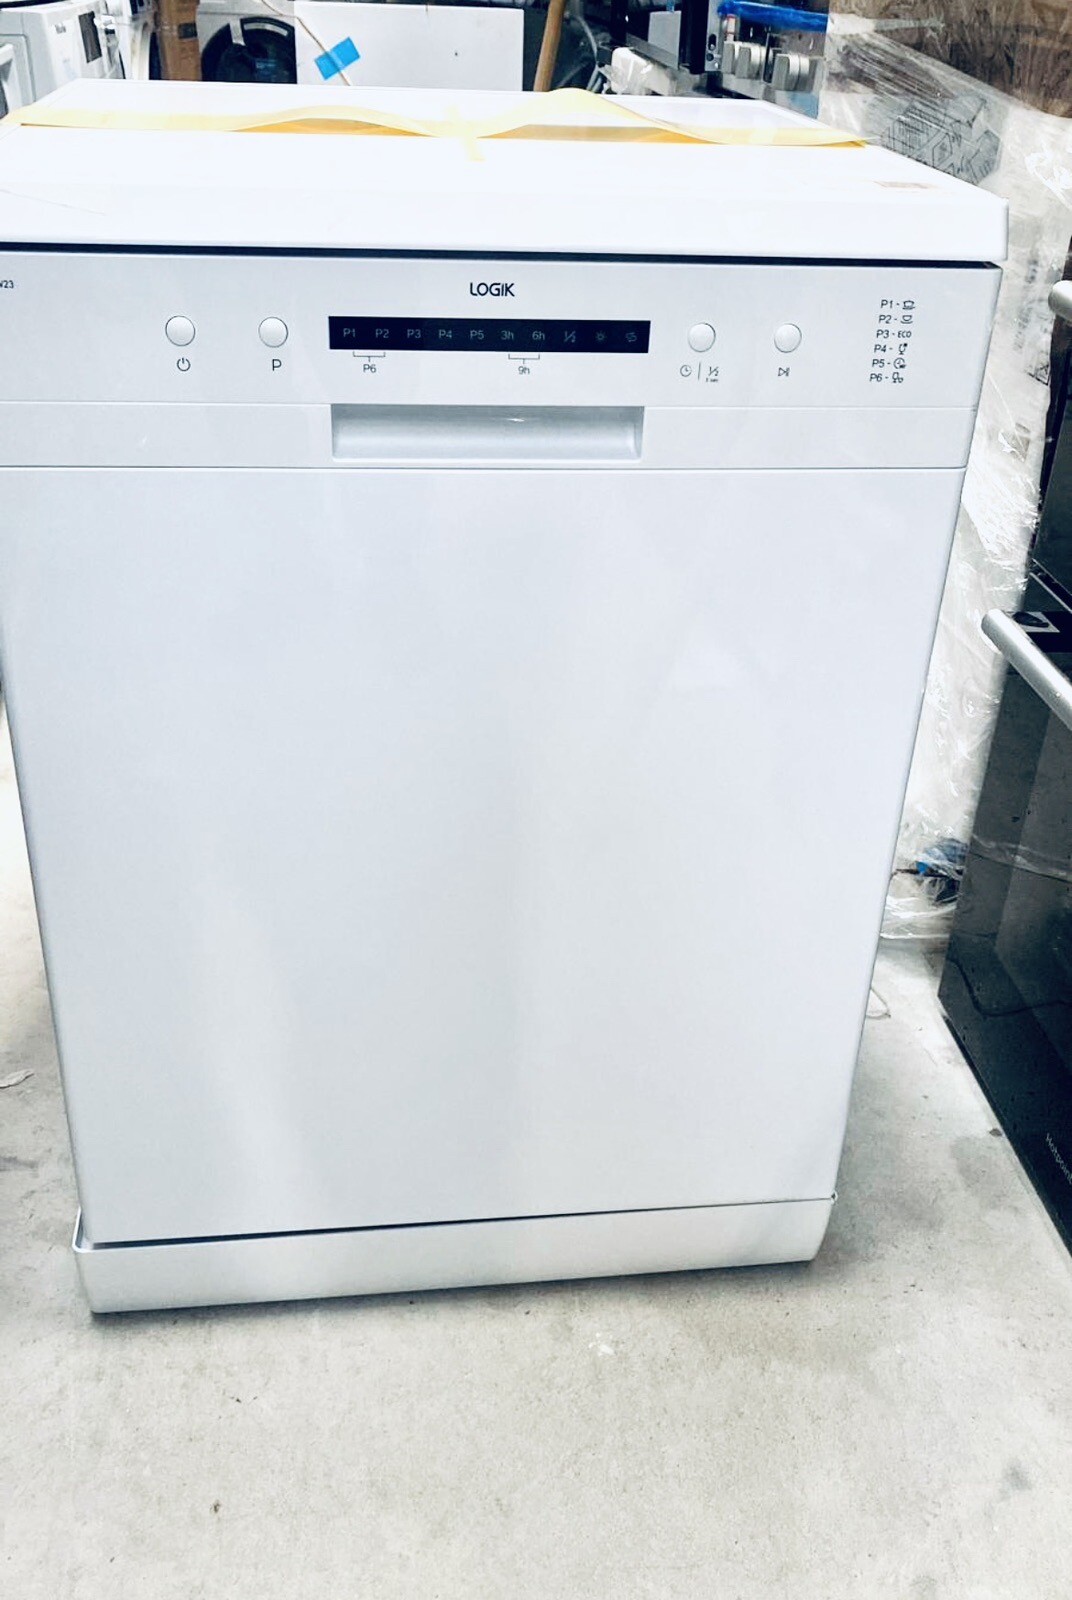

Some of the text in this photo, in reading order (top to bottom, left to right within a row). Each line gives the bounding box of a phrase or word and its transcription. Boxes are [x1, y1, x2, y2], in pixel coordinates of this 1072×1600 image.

[469, 282, 516, 297] LOGIK
[343, 328, 356, 337] P1
[375, 328, 390, 338] P2
[407, 329, 421, 339] P3
[438, 329, 452, 339] P4
[469, 329, 485, 340] P5
[501, 330, 514, 340] 3h
[532, 331, 546, 340] 6h
[897, 330, 912, 338] ECO
[272, 358, 282, 371] P
[363, 363, 377, 373] P6
[518, 365, 530, 375] 9h
